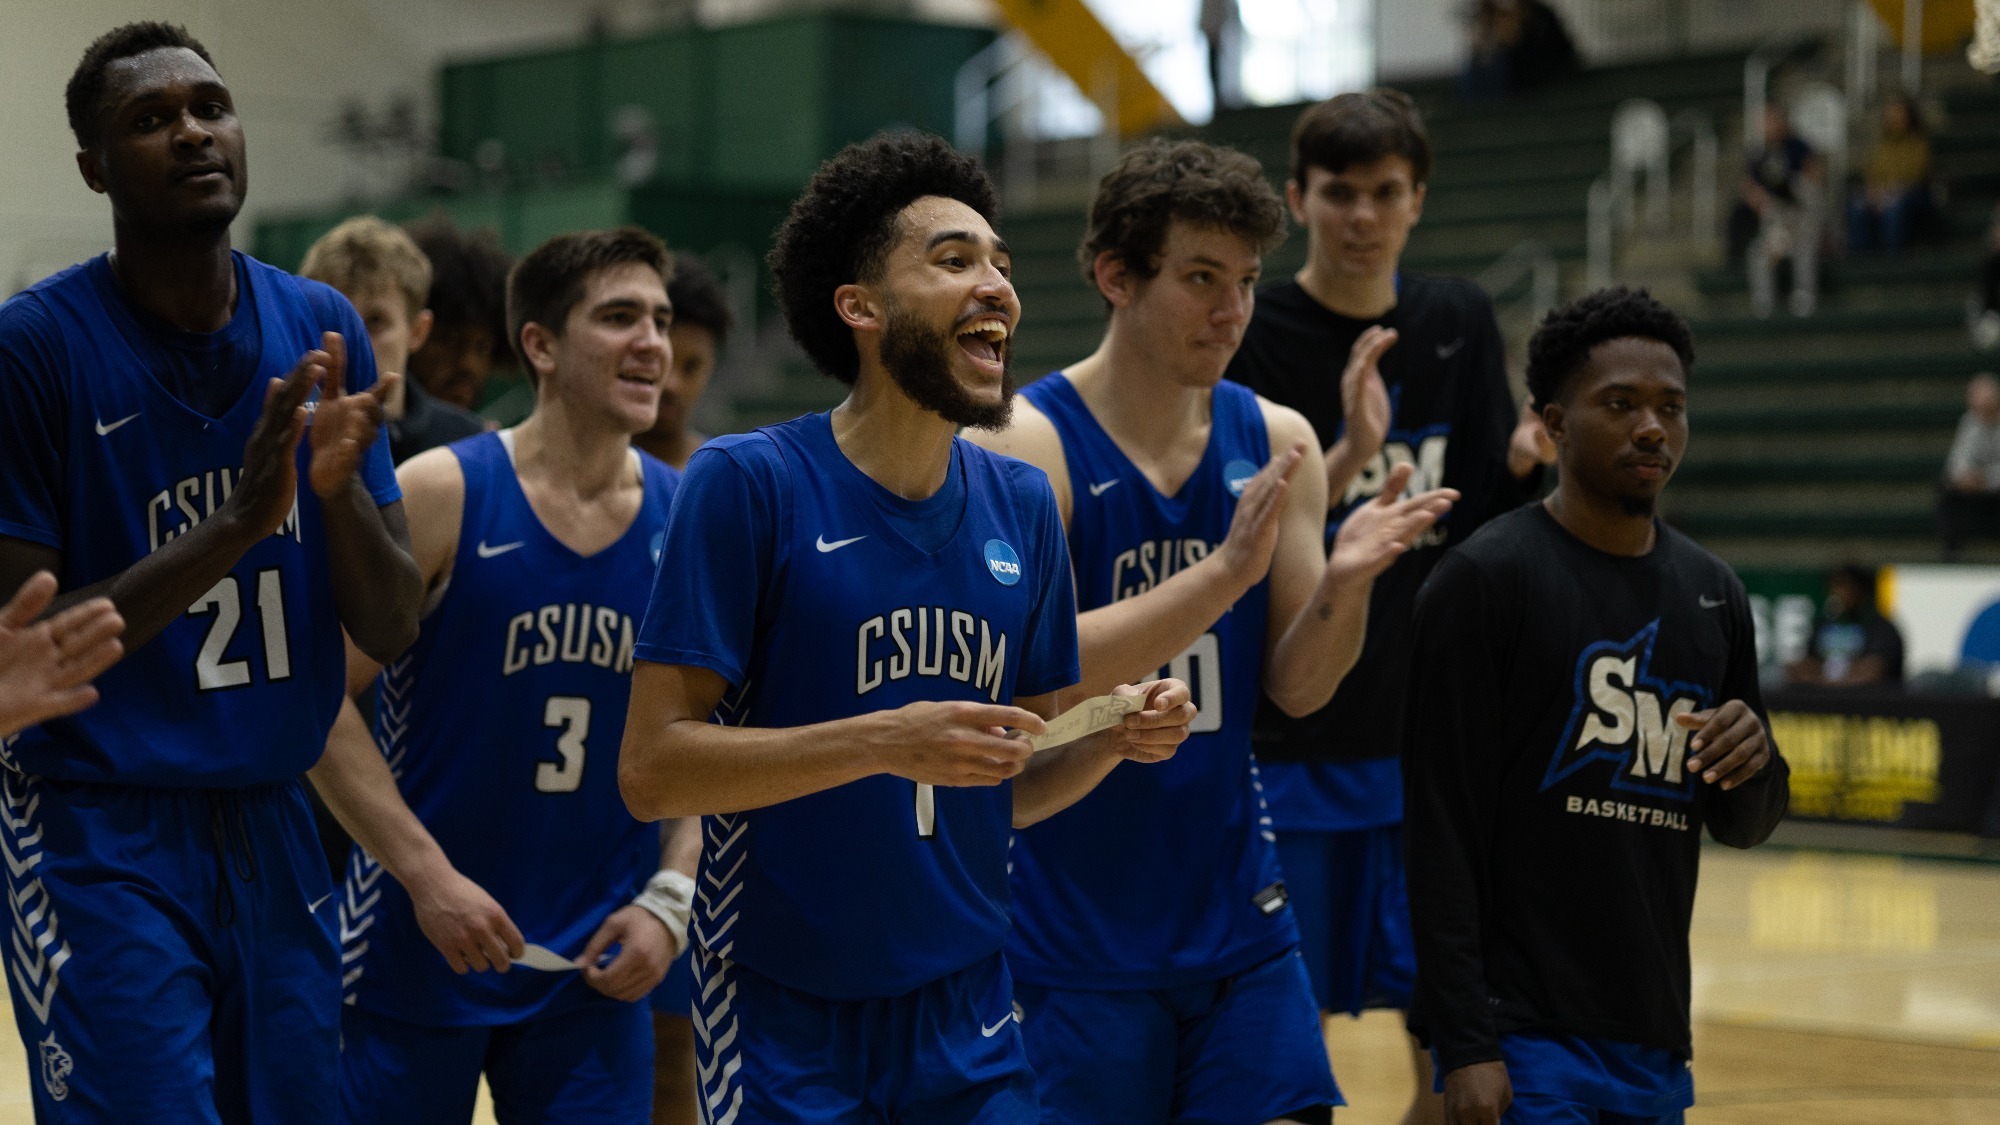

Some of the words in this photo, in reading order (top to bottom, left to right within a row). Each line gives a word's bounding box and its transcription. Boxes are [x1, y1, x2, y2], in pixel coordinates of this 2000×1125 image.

[989, 559, 1020, 576] NCAA
[187, 568, 291, 691] 21
[857, 606, 1006, 703] CSUSM
[534, 695, 592, 793] 3
[1575, 655, 1697, 784] SM
[1566, 795, 1689, 832] BASKETBALL
